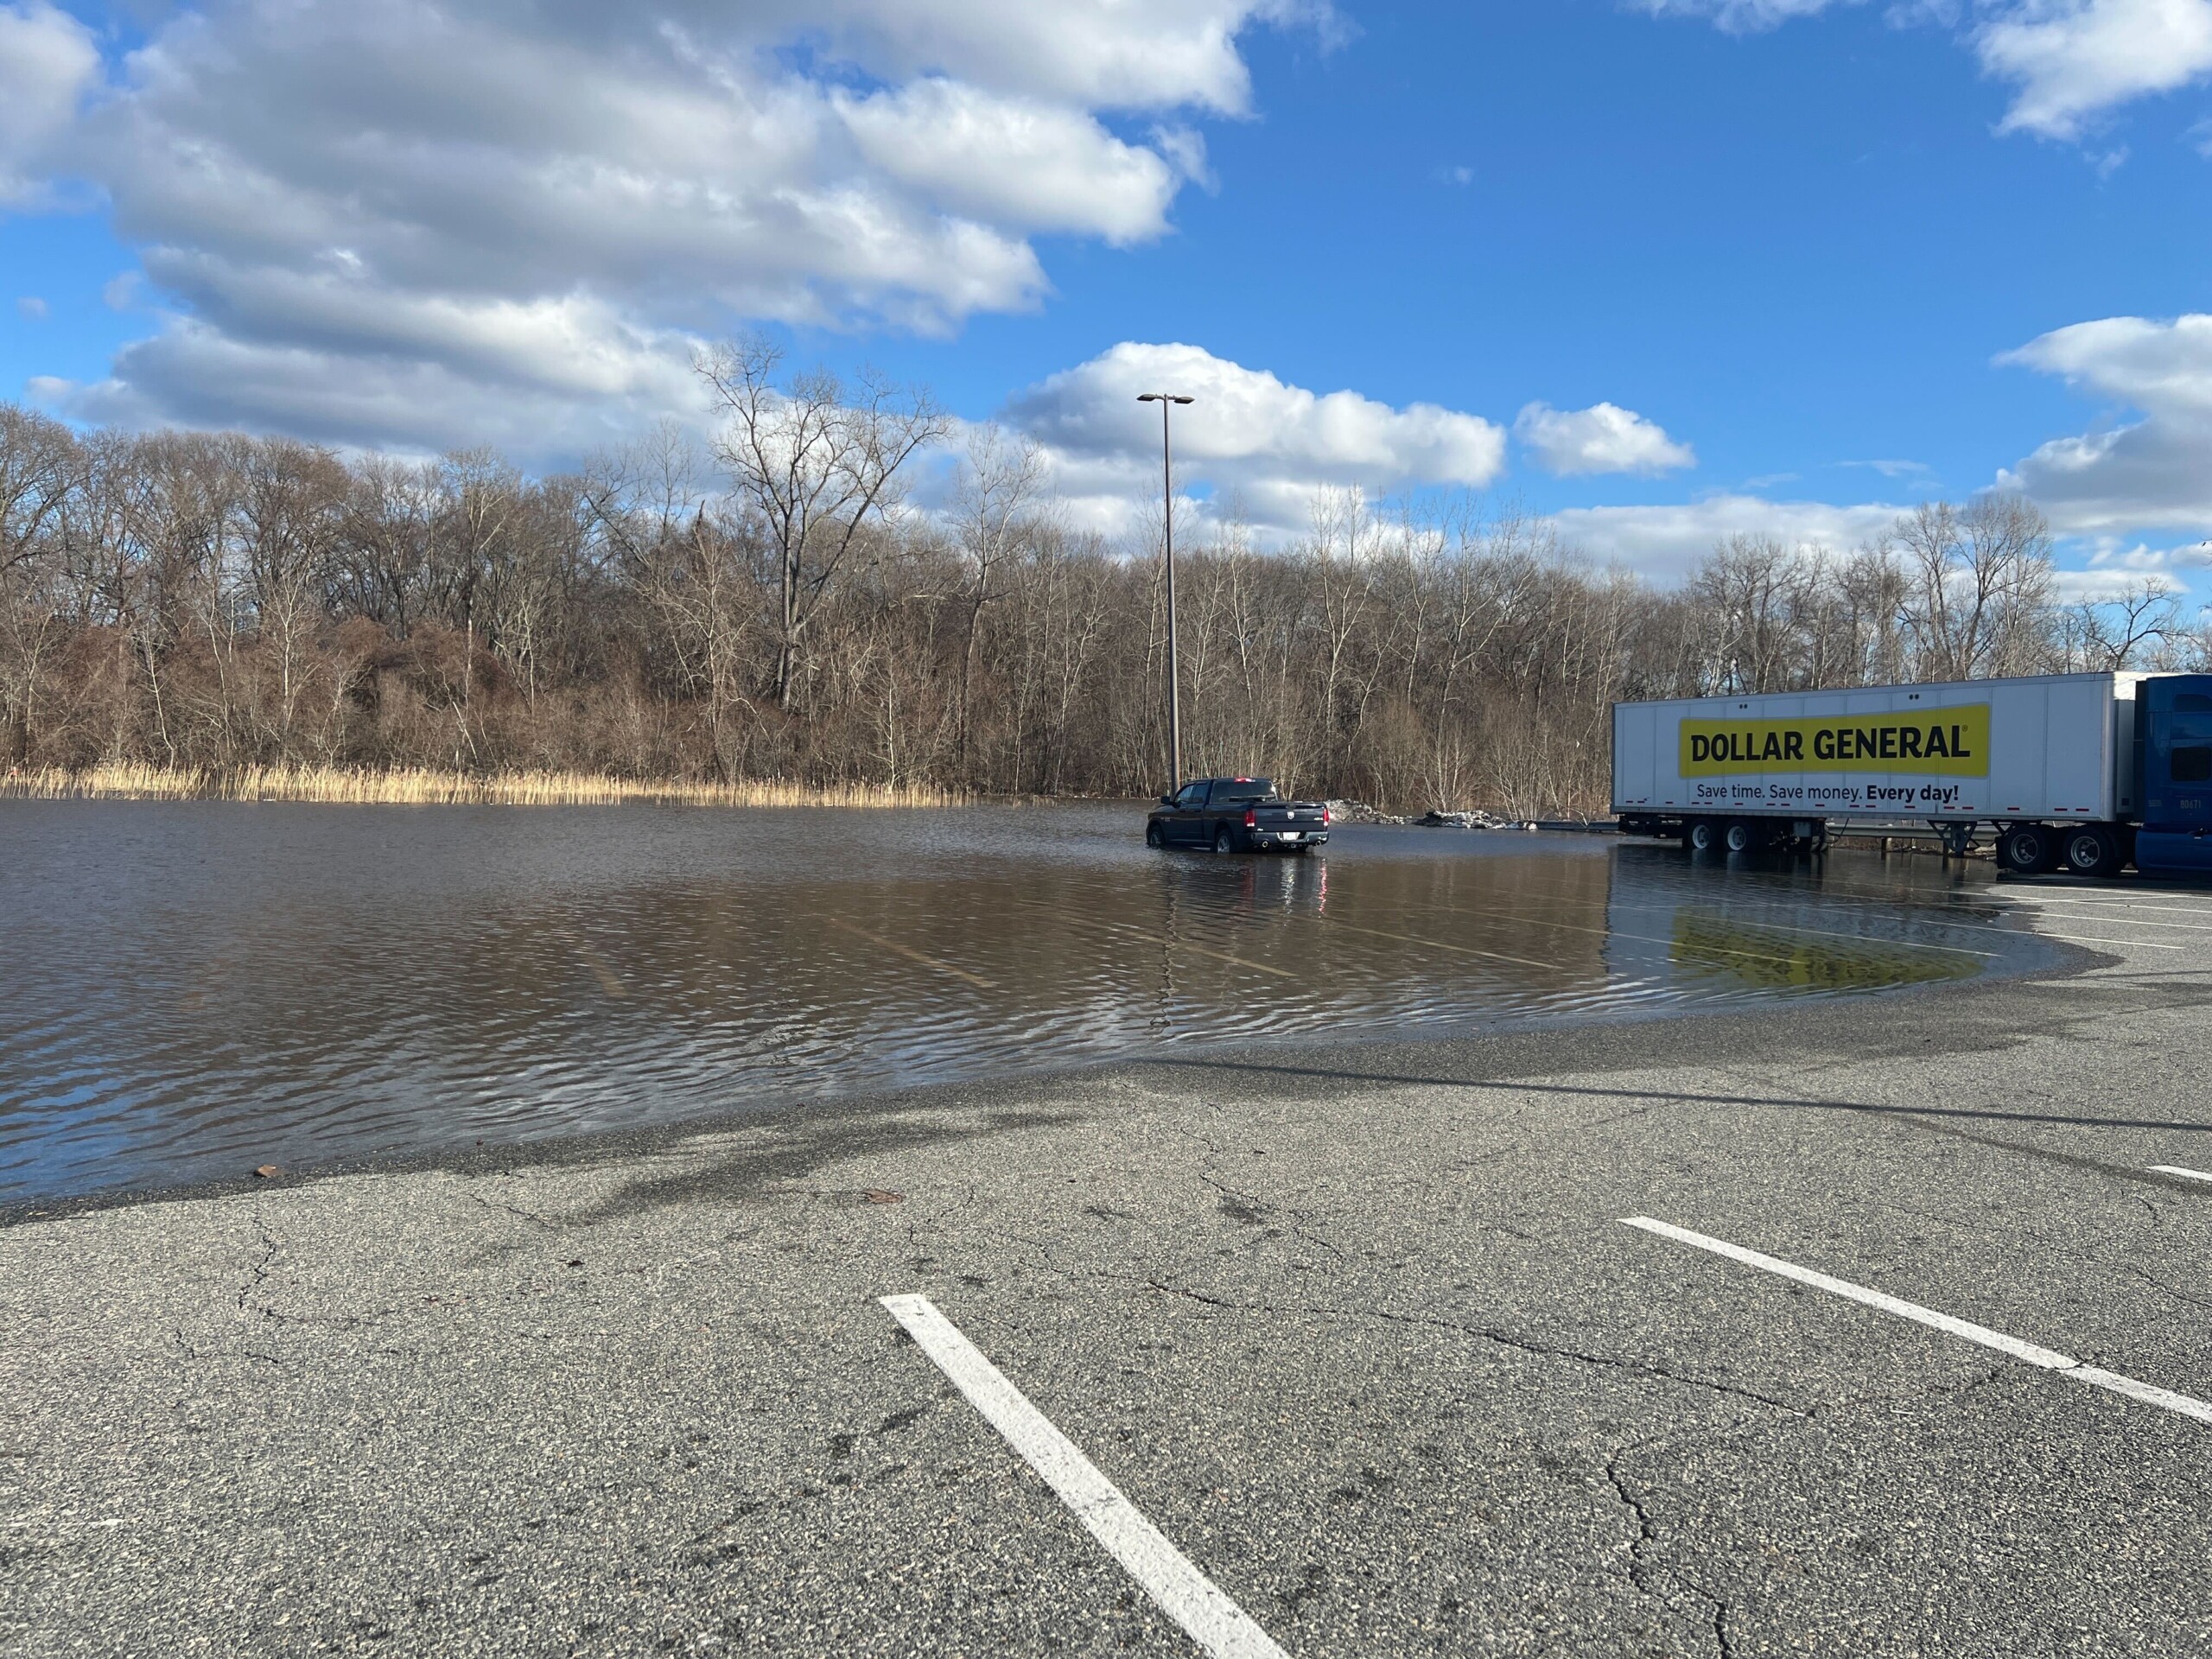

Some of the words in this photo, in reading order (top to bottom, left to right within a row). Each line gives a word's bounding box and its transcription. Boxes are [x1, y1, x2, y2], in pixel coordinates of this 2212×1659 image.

[1691, 731, 1803, 762] DOLLAR
[1814, 726, 1970, 760] GENERAL
[1697, 784, 1727, 798] Save
[1732, 784, 1765, 798] time.
[1770, 785, 1803, 798] Save
[1808, 788, 1863, 803] money.
[1866, 785, 1916, 803] Every
[1920, 785, 1959, 802] day!
[2180, 799, 2202, 809] 80671
